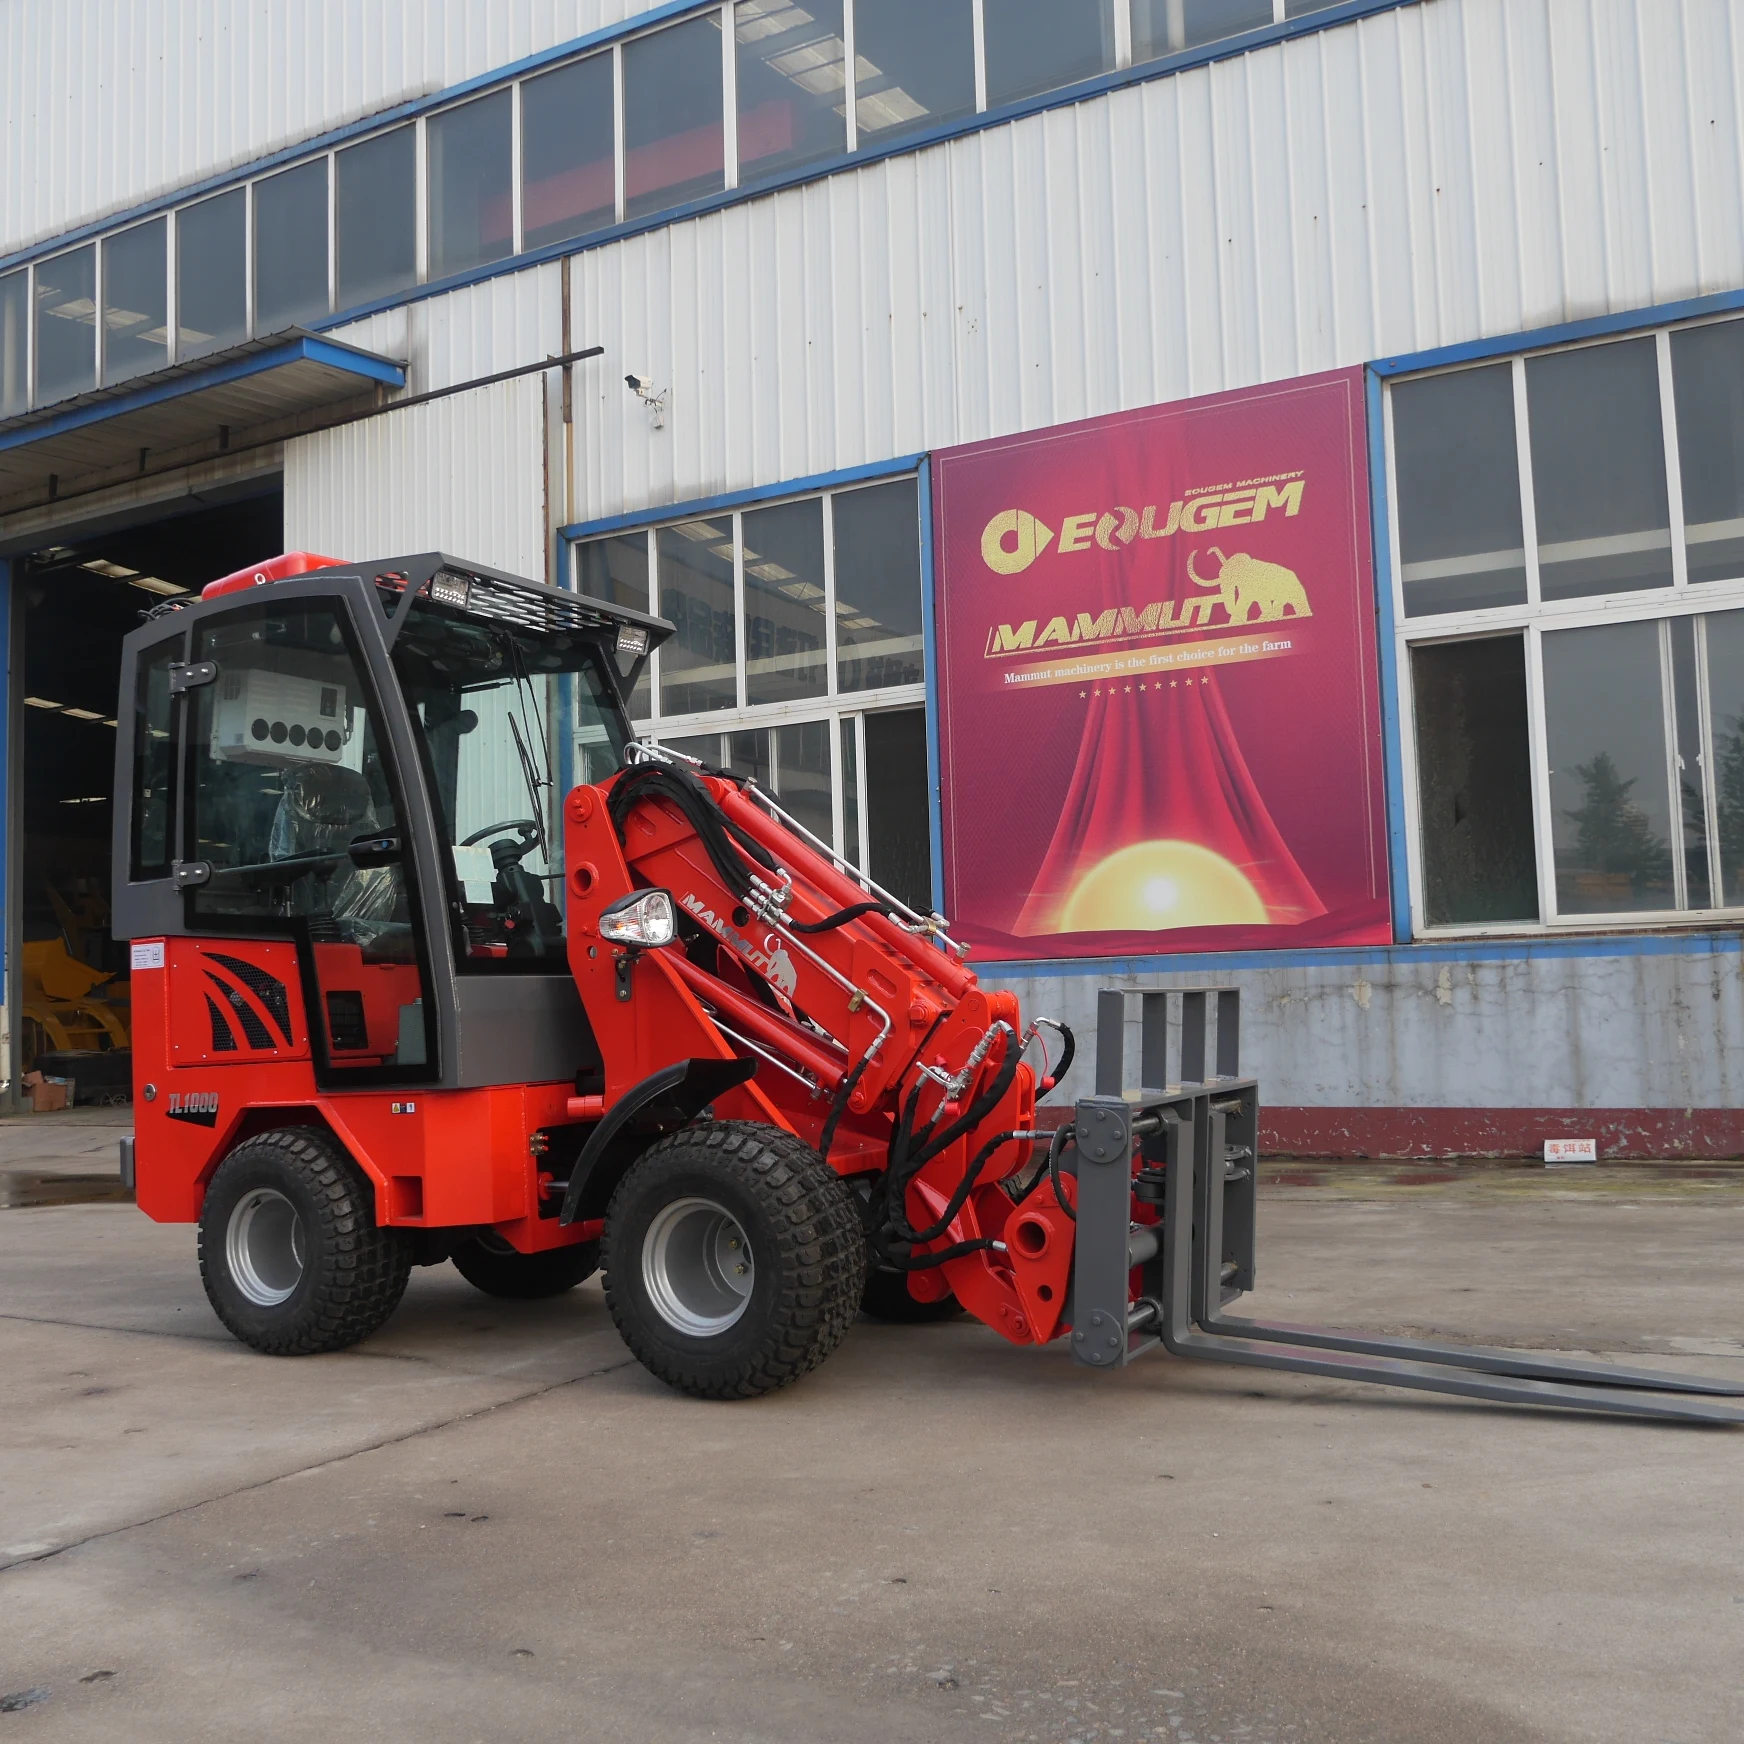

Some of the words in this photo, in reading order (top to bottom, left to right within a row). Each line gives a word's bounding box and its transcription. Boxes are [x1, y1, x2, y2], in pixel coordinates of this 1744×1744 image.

[1185, 483, 1233, 496] EOUGEM
[1236, 470, 1305, 488] MACHINERY
[1057, 480, 1306, 553] EOUGEM
[991, 592, 1227, 653] MAMMUT
[1004, 669, 1053, 684] Mammut
[1055, 663, 1112, 678] machinery
[1115, 659, 1125, 670] is
[1127, 656, 1146, 668] the
[1149, 654, 1175, 666] first
[1177, 649, 1215, 662] choice
[1218, 646, 1236, 657] for
[1239, 643, 1259, 654] the
[1262, 640, 1292, 652] farm
[682, 893, 770, 969] MAMMUT
[169, 1092, 219, 1114] TL1000
